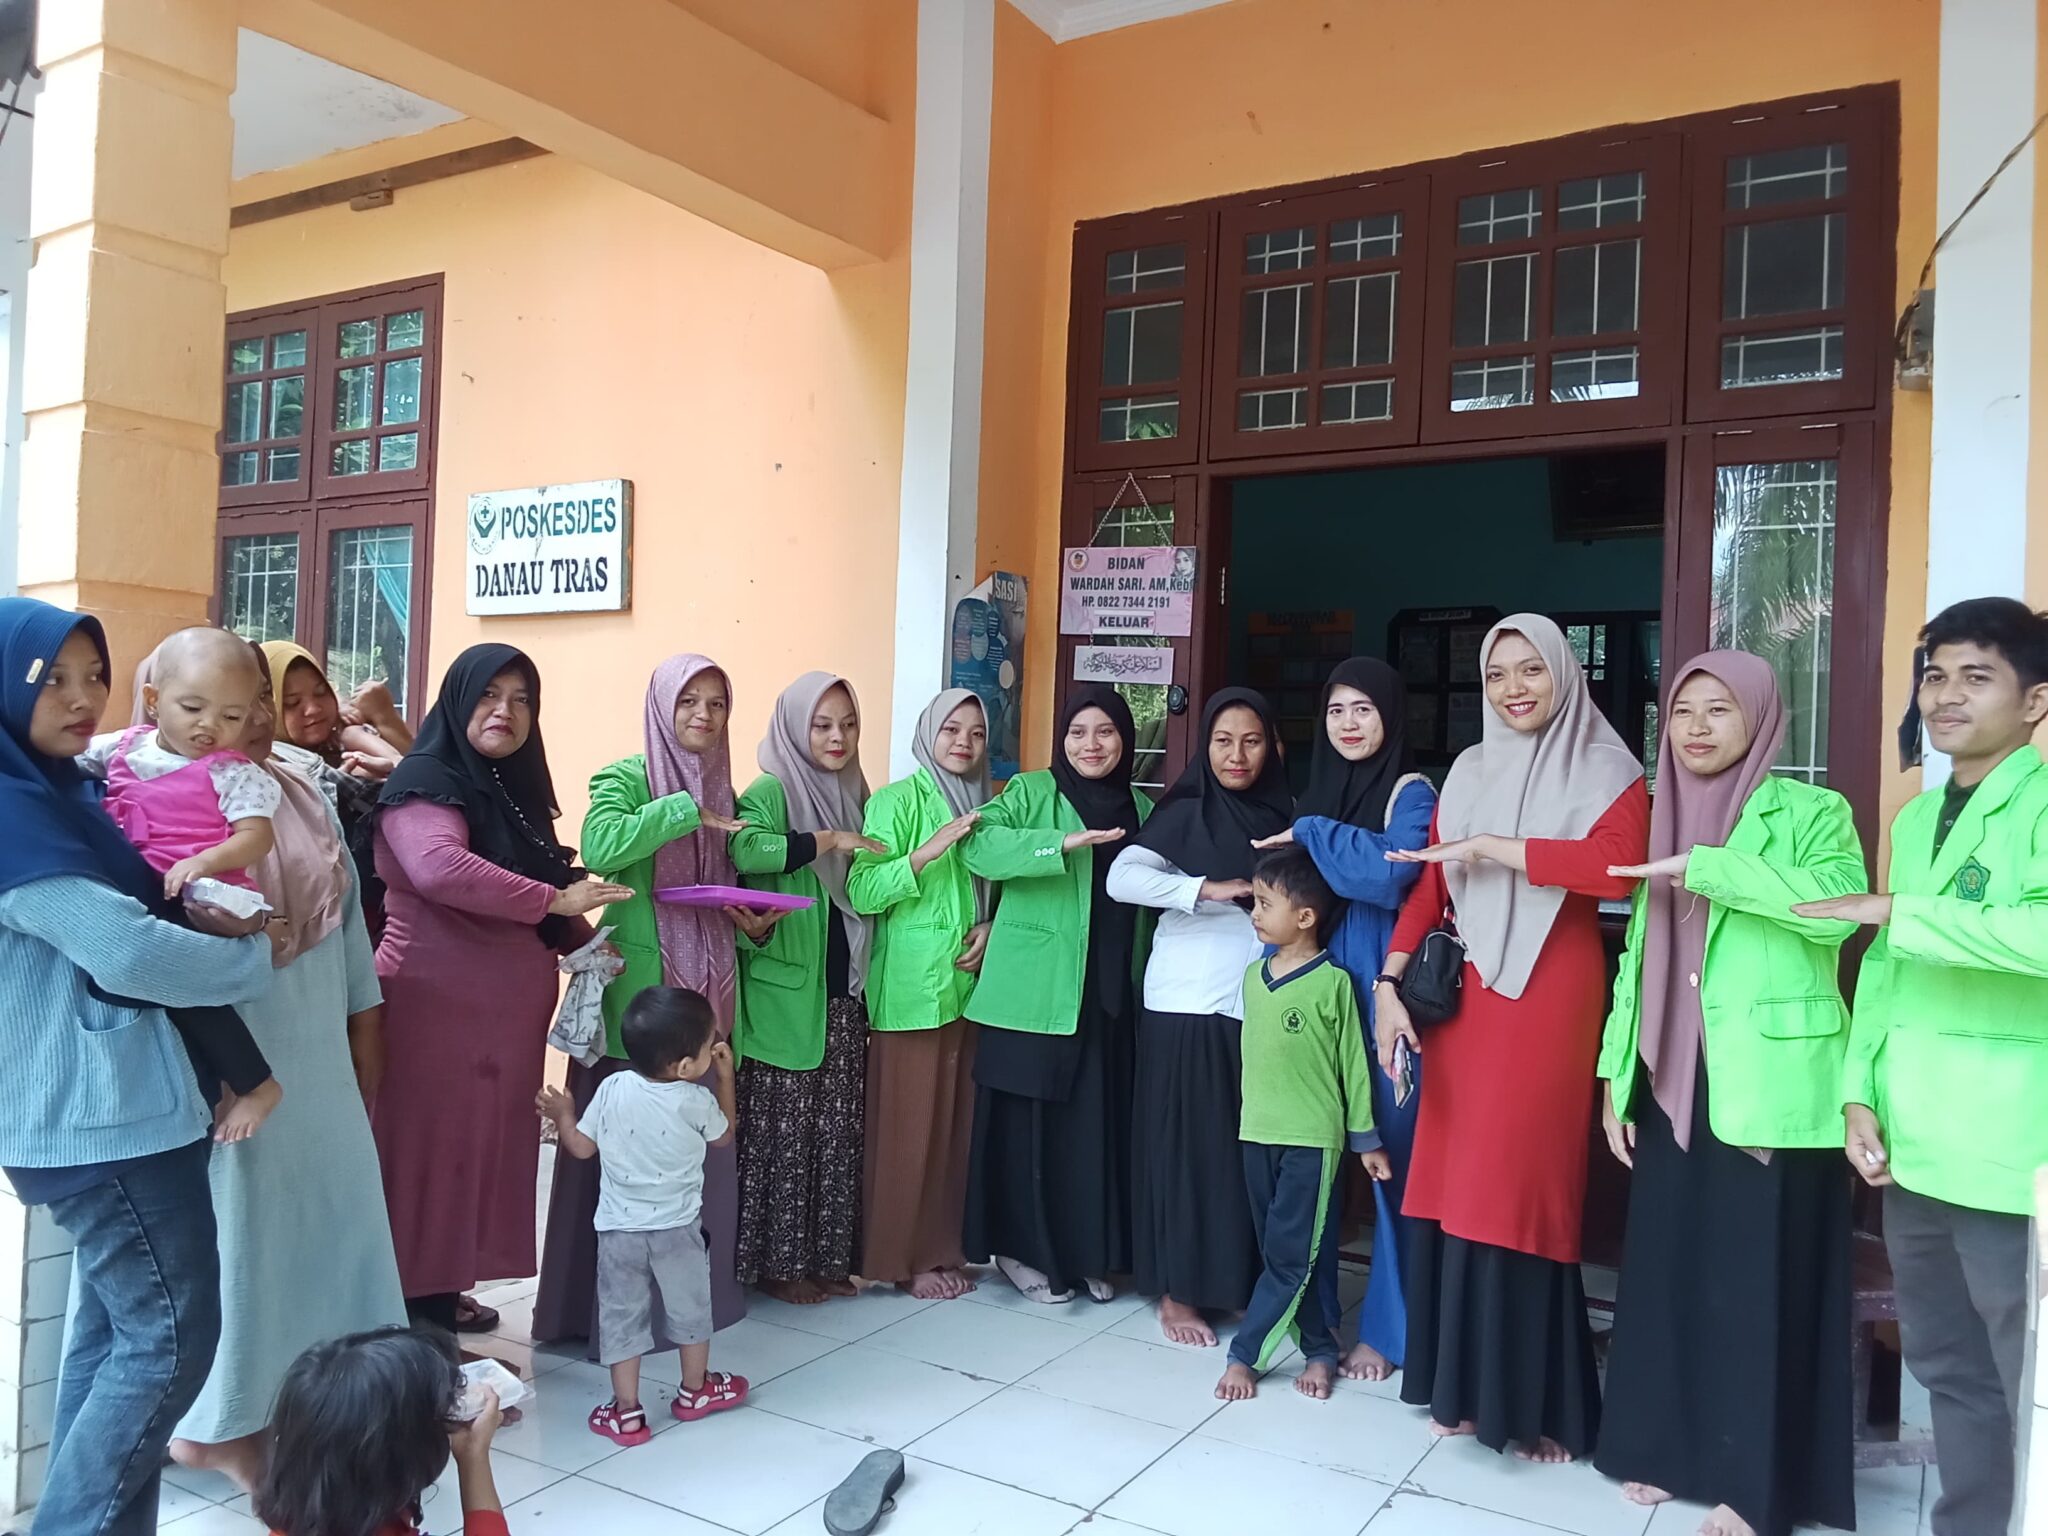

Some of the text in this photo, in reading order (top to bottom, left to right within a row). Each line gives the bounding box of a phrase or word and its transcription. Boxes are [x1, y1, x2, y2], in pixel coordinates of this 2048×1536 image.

[501, 497, 617, 540] POSKESDES
[1108, 557, 1145, 570] BIDAN
[476, 556, 608, 597] DANAU TRAS
[1070, 577, 1115, 590] WARDAH
[1118, 577, 1145, 590] SARI.
[1082, 596, 1170, 608] HP. 0822 7344 2191
[1099, 616, 1149, 628] KELUAR
